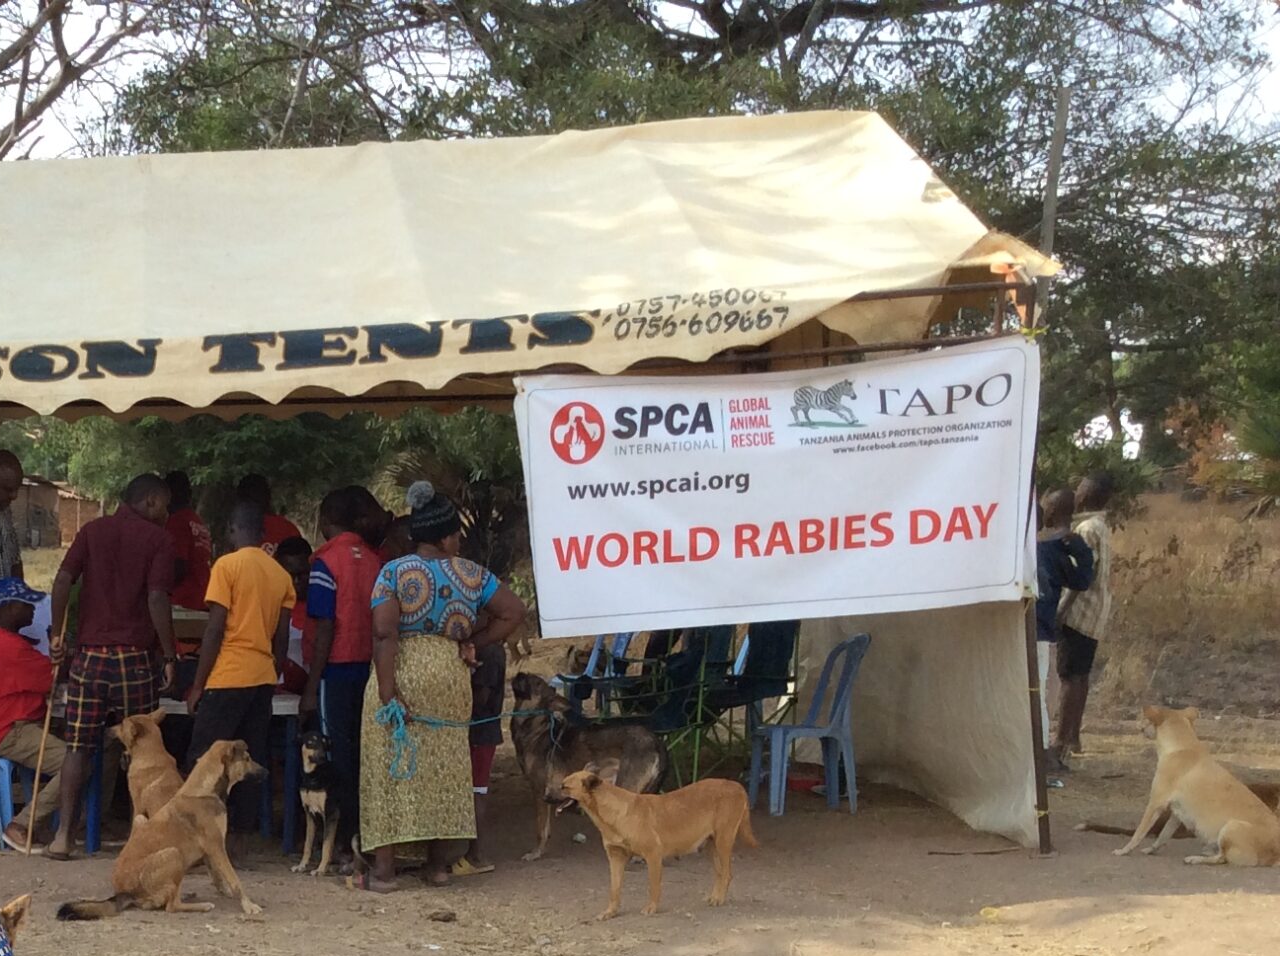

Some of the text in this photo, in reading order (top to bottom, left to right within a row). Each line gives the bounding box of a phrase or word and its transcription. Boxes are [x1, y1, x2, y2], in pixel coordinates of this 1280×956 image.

[200, 308, 602, 374] TENTS
[728, 397, 772, 413] GLOBAL
[611, 402, 714, 440] SPCA
[730, 415, 772, 431] ANIMAL
[799, 419, 1013, 446] TANZANIA ANIMALS PROTECTION ORGANIZATION
[614, 439, 718, 456] INTERNATIONAL
[731, 432, 776, 448] RESCUE
[567, 471, 750, 500] www.spcai.org
[552, 502, 999, 572] WORLD RABIES DAY
